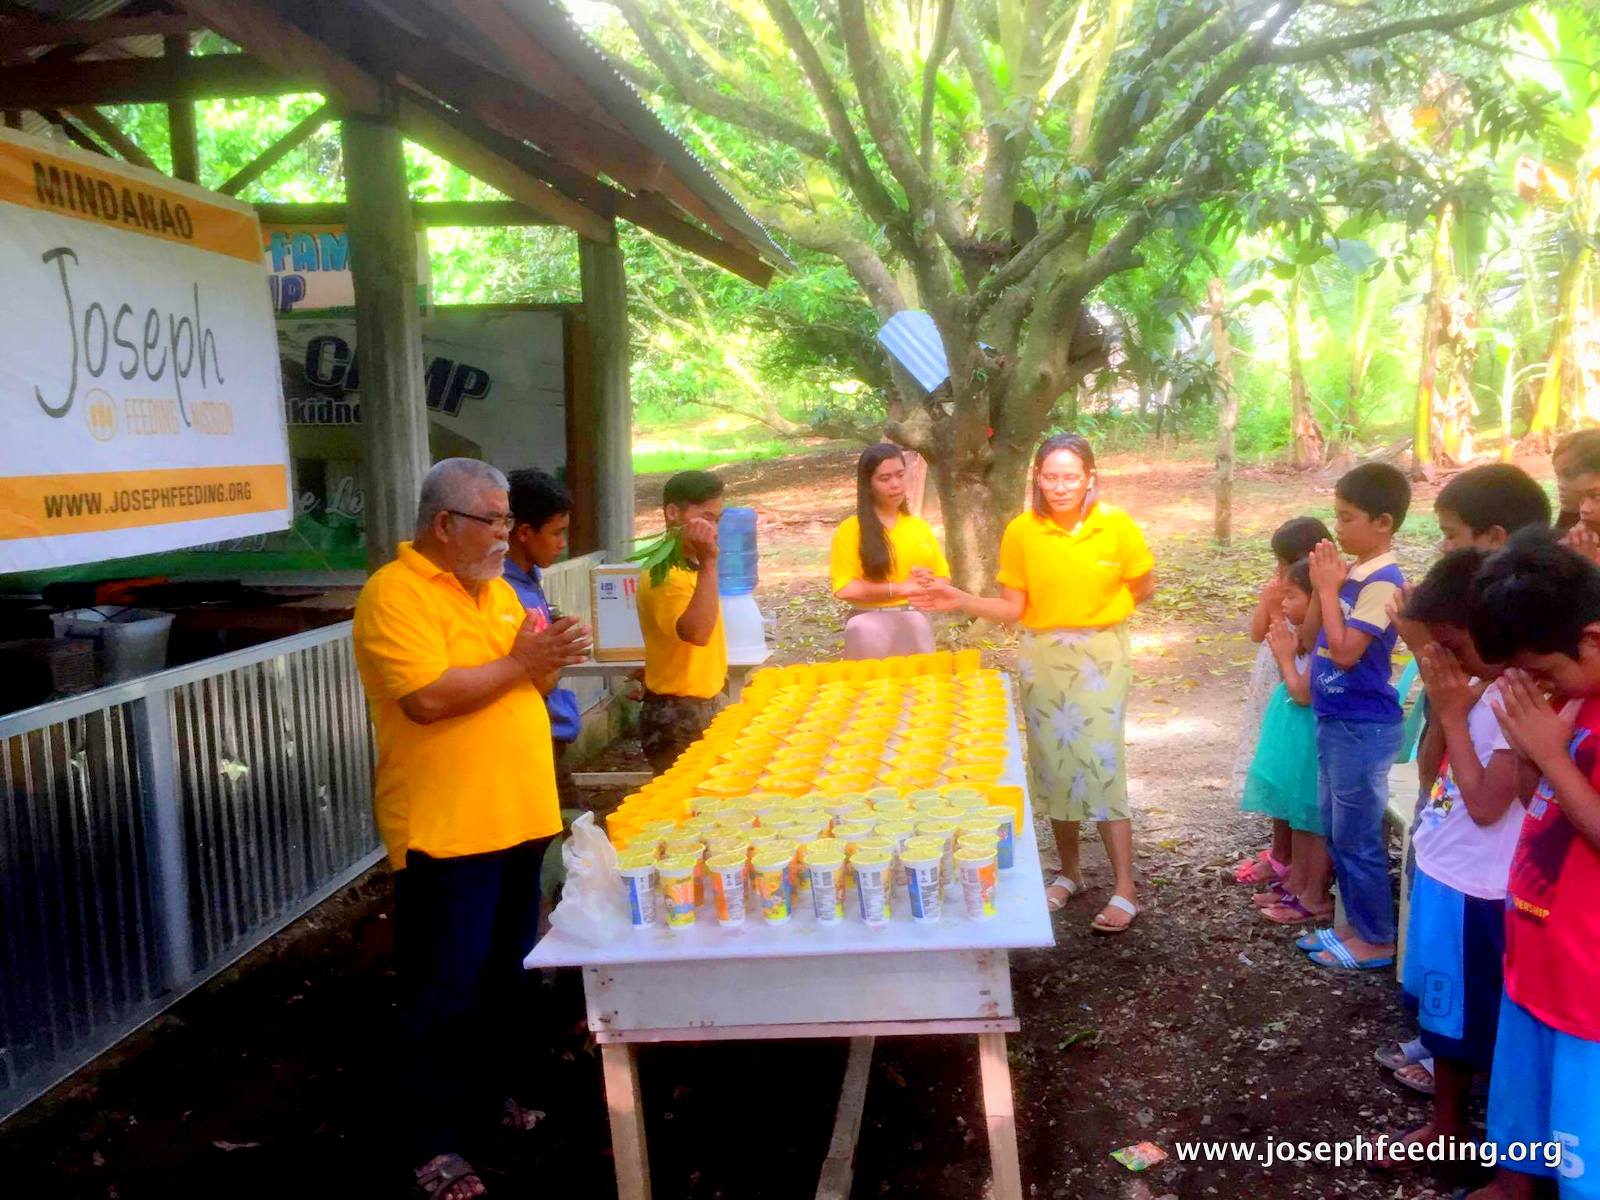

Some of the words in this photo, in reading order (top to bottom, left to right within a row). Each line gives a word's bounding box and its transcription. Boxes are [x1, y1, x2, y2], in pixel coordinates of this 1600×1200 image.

[33, 161, 195, 239] MINDANAO
[34, 246, 225, 427] Joseph
[124, 398, 181, 435] FEEDING
[43, 481, 252, 518] WWW.JOSEPHFEEDING.ORG
